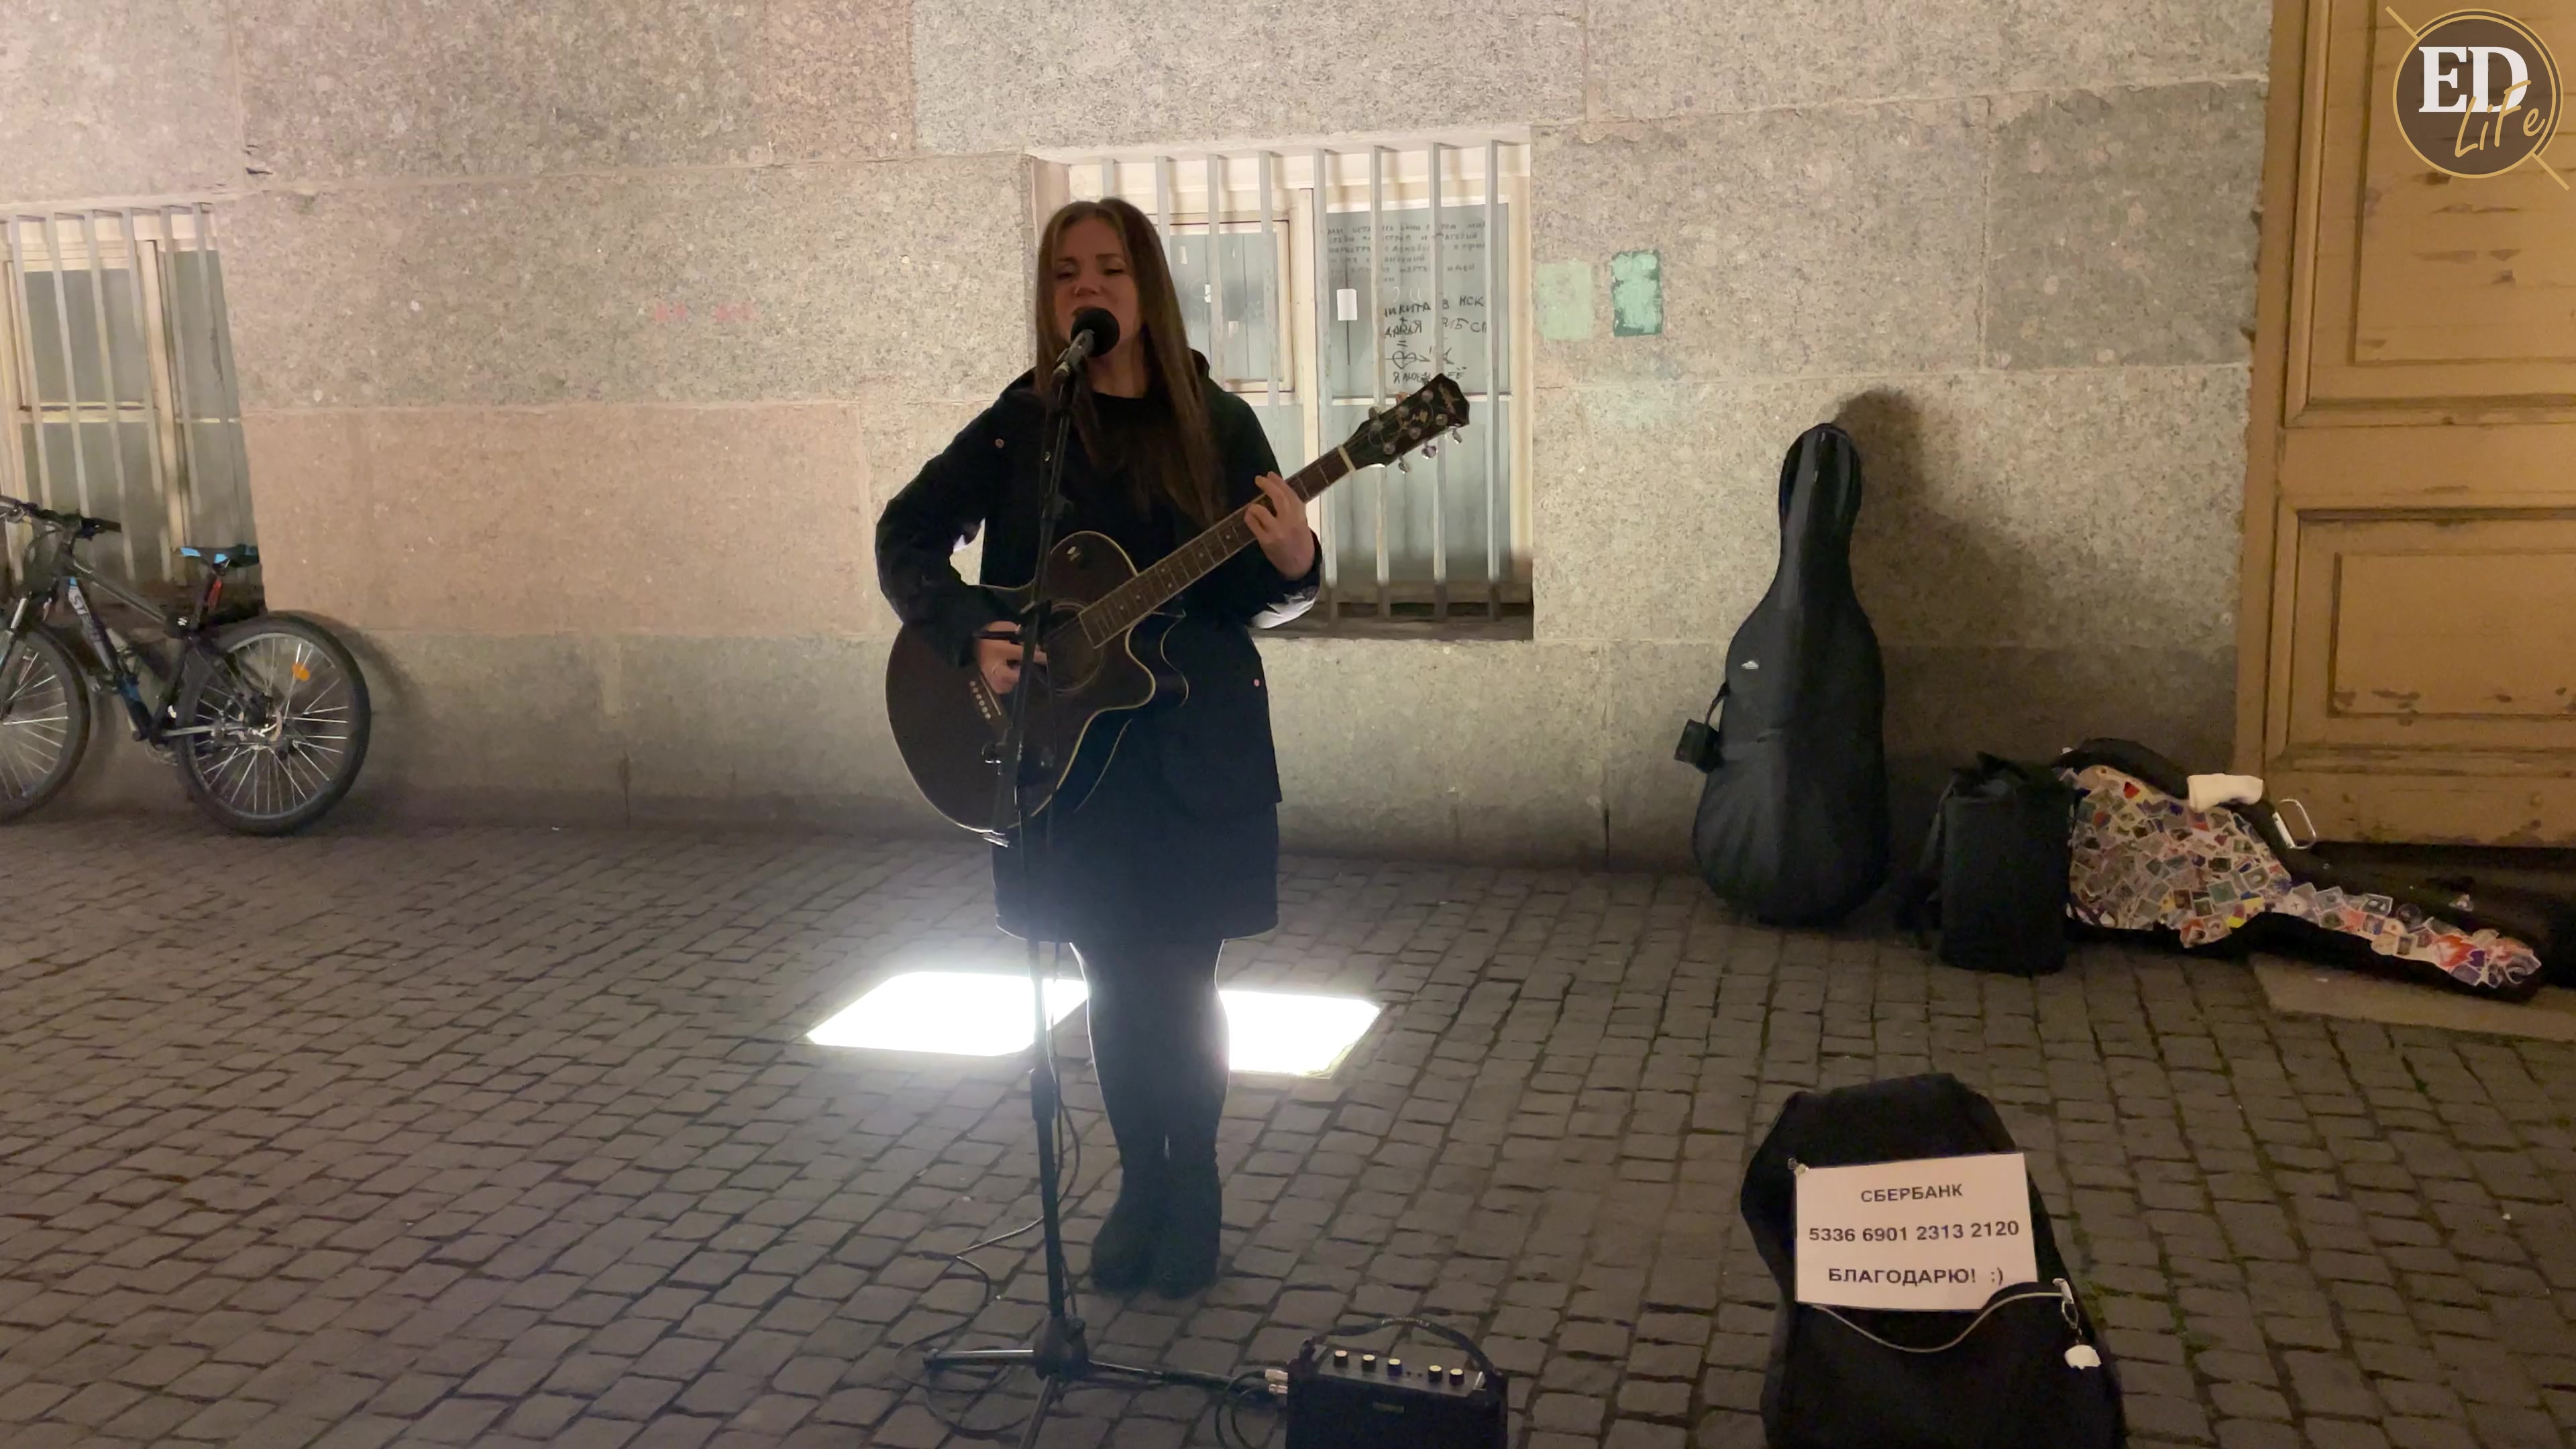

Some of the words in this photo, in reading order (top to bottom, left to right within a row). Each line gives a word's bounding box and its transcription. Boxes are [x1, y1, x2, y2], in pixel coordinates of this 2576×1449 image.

[1861, 1183, 1963, 1203] СБЕРБАНК
[1809, 1228, 1856, 1242] 5336
[1862, 1226, 1907, 1242] 6901
[1917, 1224, 1964, 1240] 2313
[1971, 1220, 2019, 1237] 2120
[1829, 1268, 1976, 1287] БЛАГОДАРЮ!
